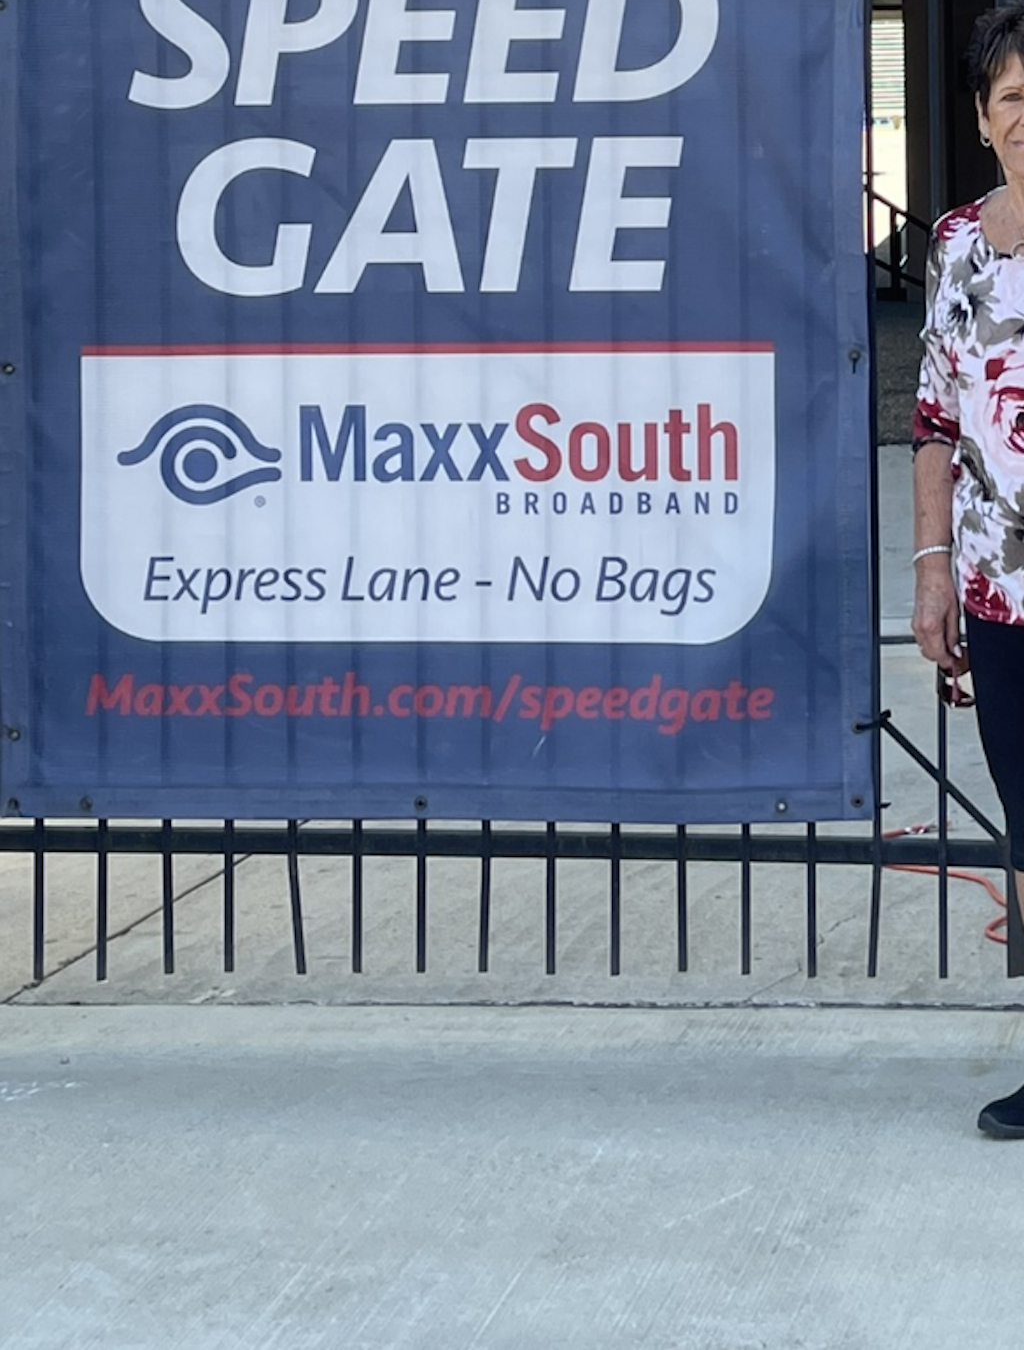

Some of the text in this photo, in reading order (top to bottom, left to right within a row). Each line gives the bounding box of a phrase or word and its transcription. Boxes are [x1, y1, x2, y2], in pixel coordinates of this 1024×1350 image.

[175, 136, 684, 297] GATE
[299, 402, 740, 483] MaxxSouth
[496, 491, 741, 516] BROADBAND
[142, 555, 328, 614] Express
[341, 556, 460, 603] Lane
[506, 557, 582, 602] No
[596, 556, 717, 614] Bags
[84, 672, 776, 735] MaxxSouth.com/speedgate
